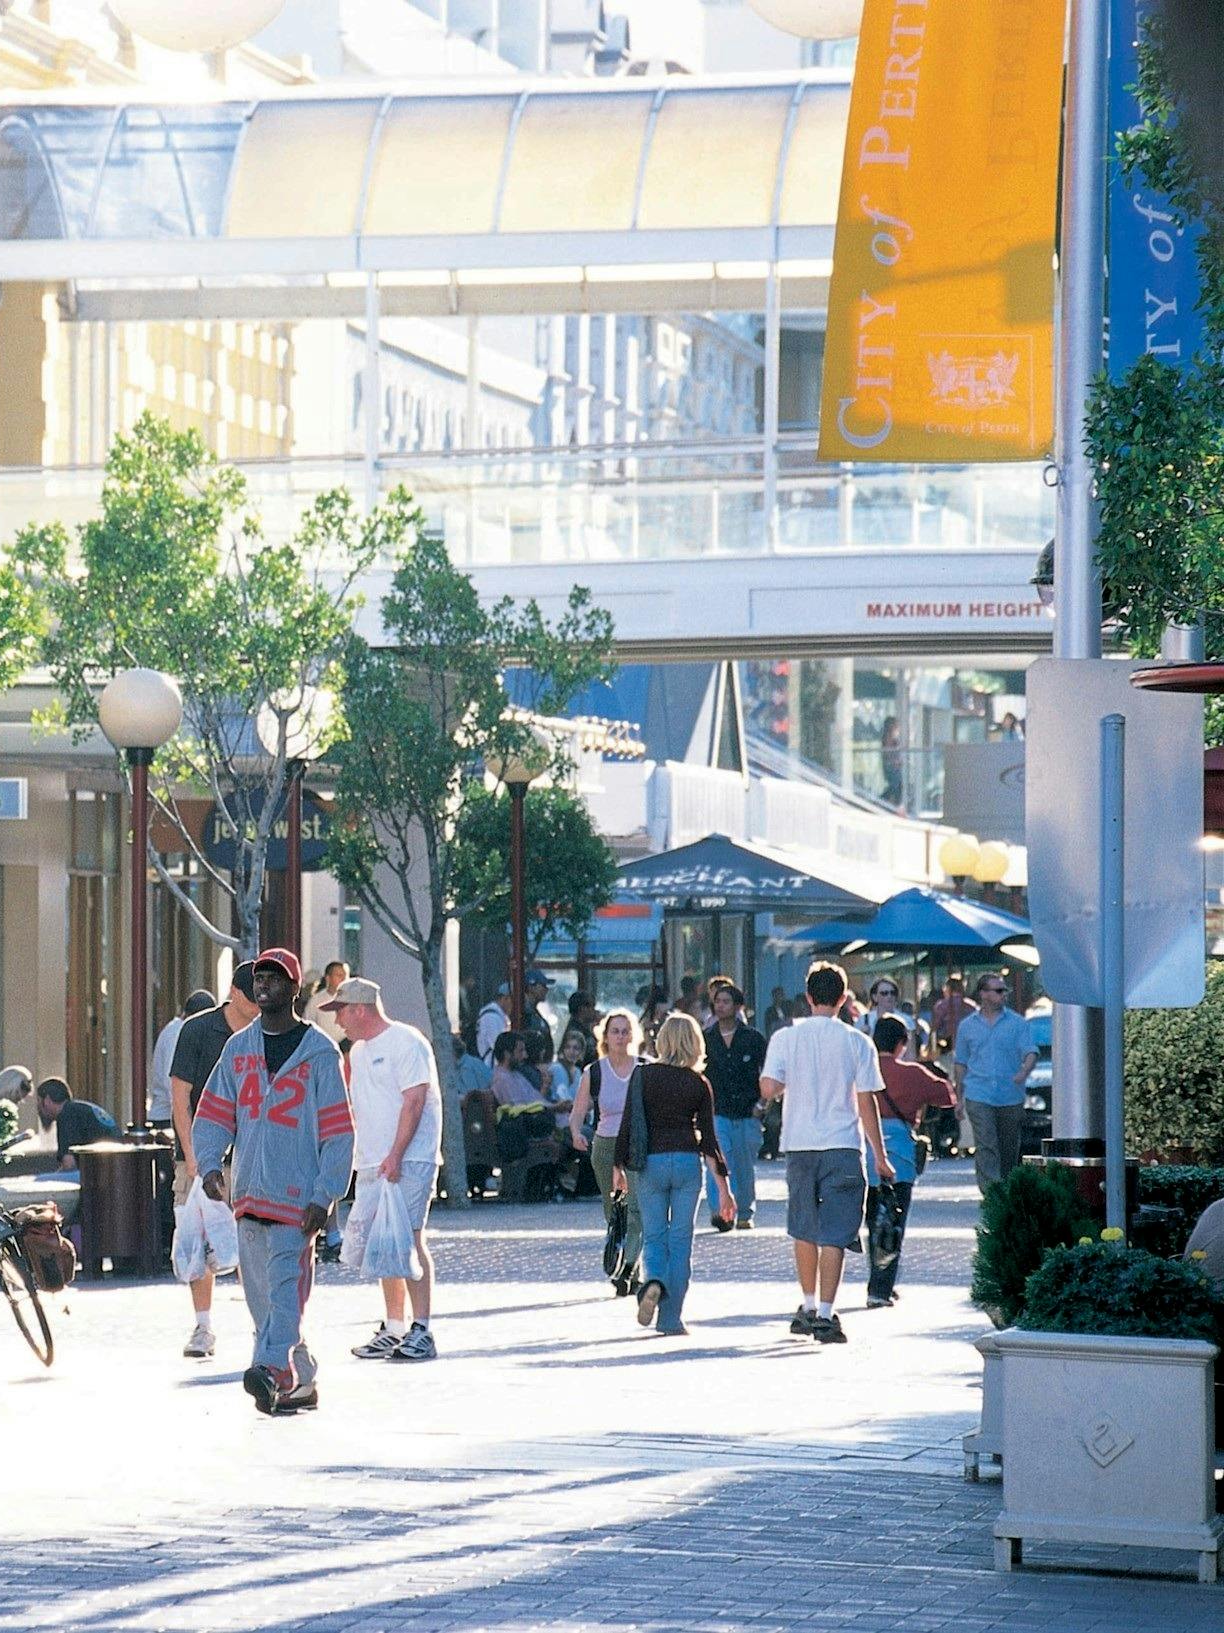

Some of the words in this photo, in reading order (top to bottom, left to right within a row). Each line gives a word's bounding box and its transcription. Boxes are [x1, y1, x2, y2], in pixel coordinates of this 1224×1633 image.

[859, 0, 929, 171] PERT
[859, 194, 914, 266] of
[1133, 193, 1185, 263] of
[1146, 288, 1181, 358] TY
[837, 289, 897, 449] CITY
[866, 603, 961, 617] MAXIMUM
[969, 602, 1043, 617] HEIGHT
[239, 1072, 306, 1128] 42
